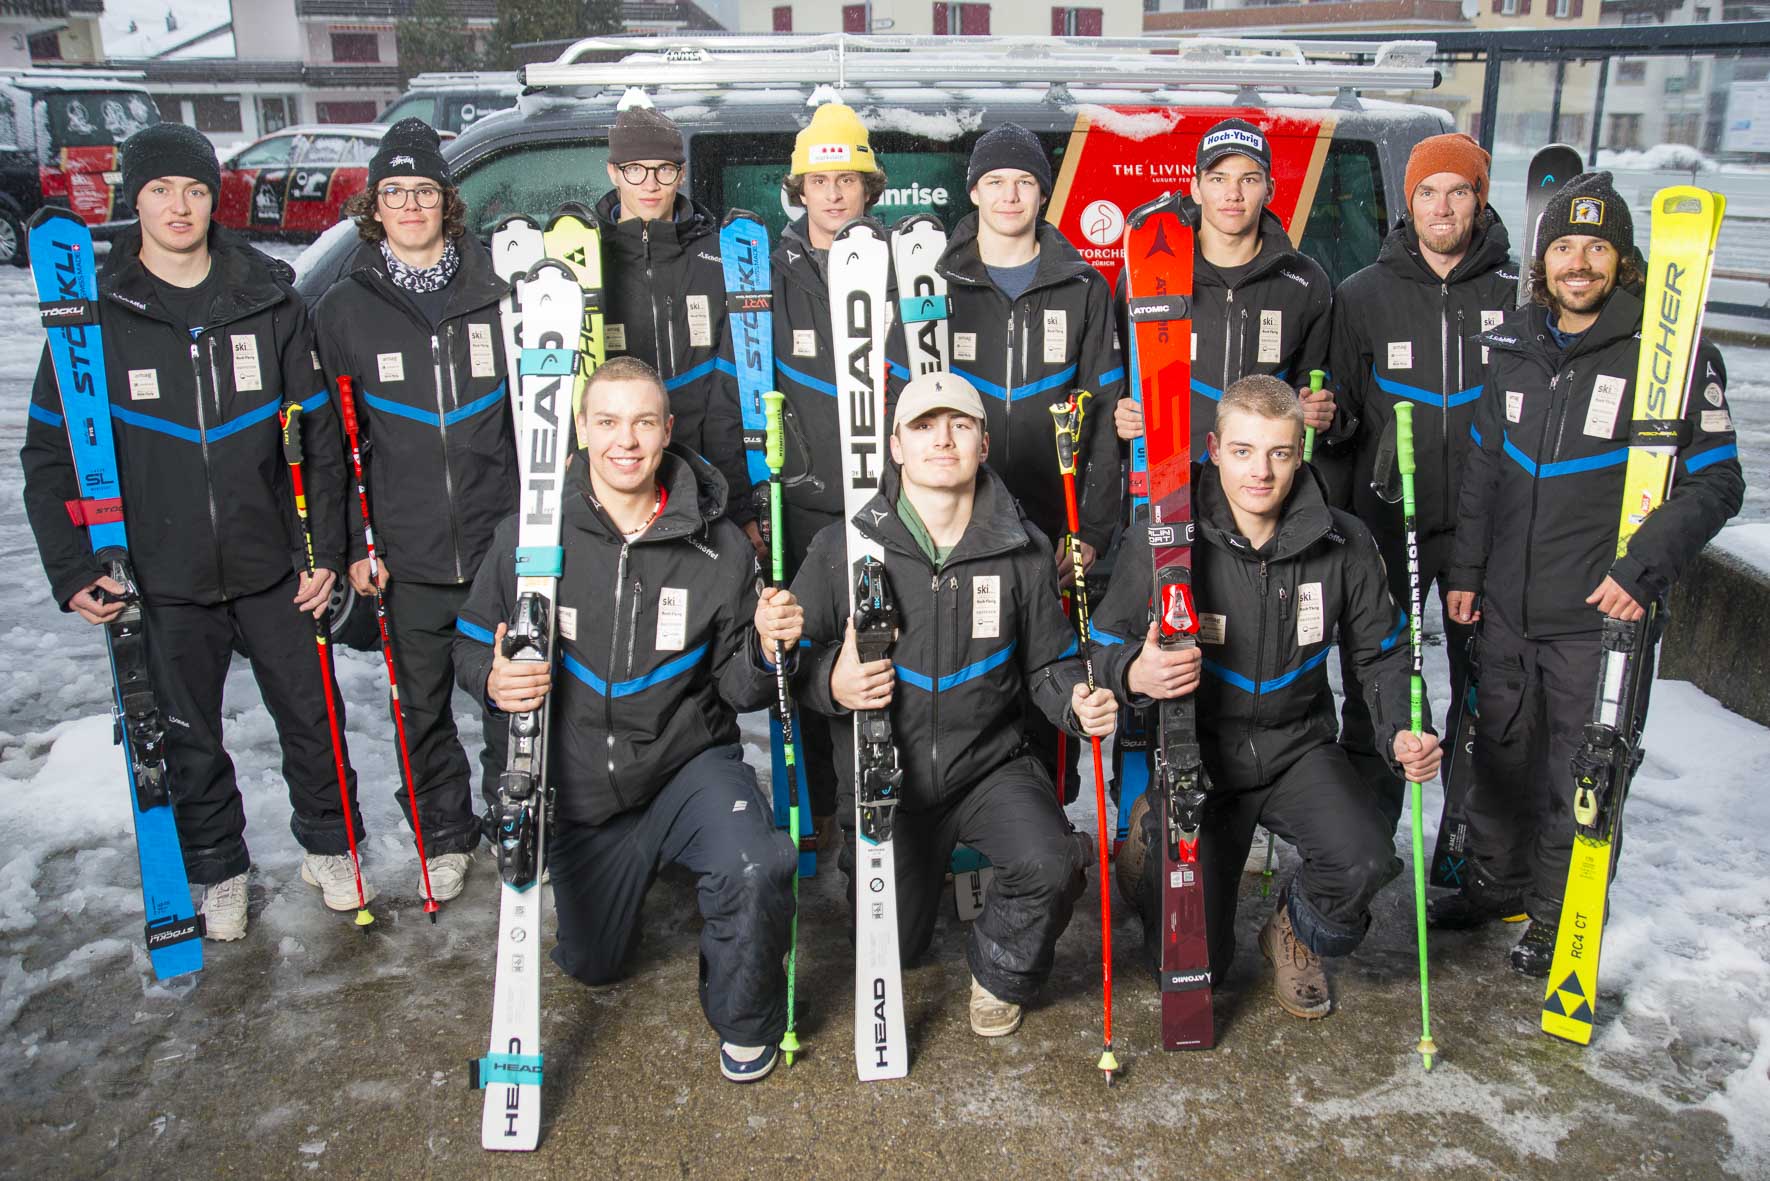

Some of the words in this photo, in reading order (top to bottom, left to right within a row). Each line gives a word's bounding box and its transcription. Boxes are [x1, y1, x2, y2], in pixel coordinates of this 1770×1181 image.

[1207, 131, 1259, 147] Hoch-Ybrig
[1113, 164, 1143, 176] THE
[874, 182, 949, 206] nrise
[1079, 248, 1126, 259] TORCHE
[736, 237, 762, 372] STÖKLI
[1134, 304, 1170, 315] ATOMIC
[1156, 276, 1169, 344] ATIC
[52, 240, 96, 398] STÖKLI
[1263, 316, 1273, 326] ski
[235, 342, 247, 352] ski
[1645, 262, 1686, 420] SCHER
[846, 289, 878, 489] HEAD
[85, 473, 115, 487] SL
[1071, 537, 1085, 587] LEKI
[977, 584, 989, 595] ski
[1299, 592, 1312, 602] ski
[662, 596, 676, 607] ski
[1407, 531, 1422, 671] KOMPERDELL
[1575, 912, 1587, 929] CT
[1571, 934, 1584, 960] RC4
[1172, 975, 1206, 984] ATOMIC
[875, 977, 888, 1068] HEAD
[494, 1063, 544, 1074] HEAD
[504, 1037, 522, 1137] HED
